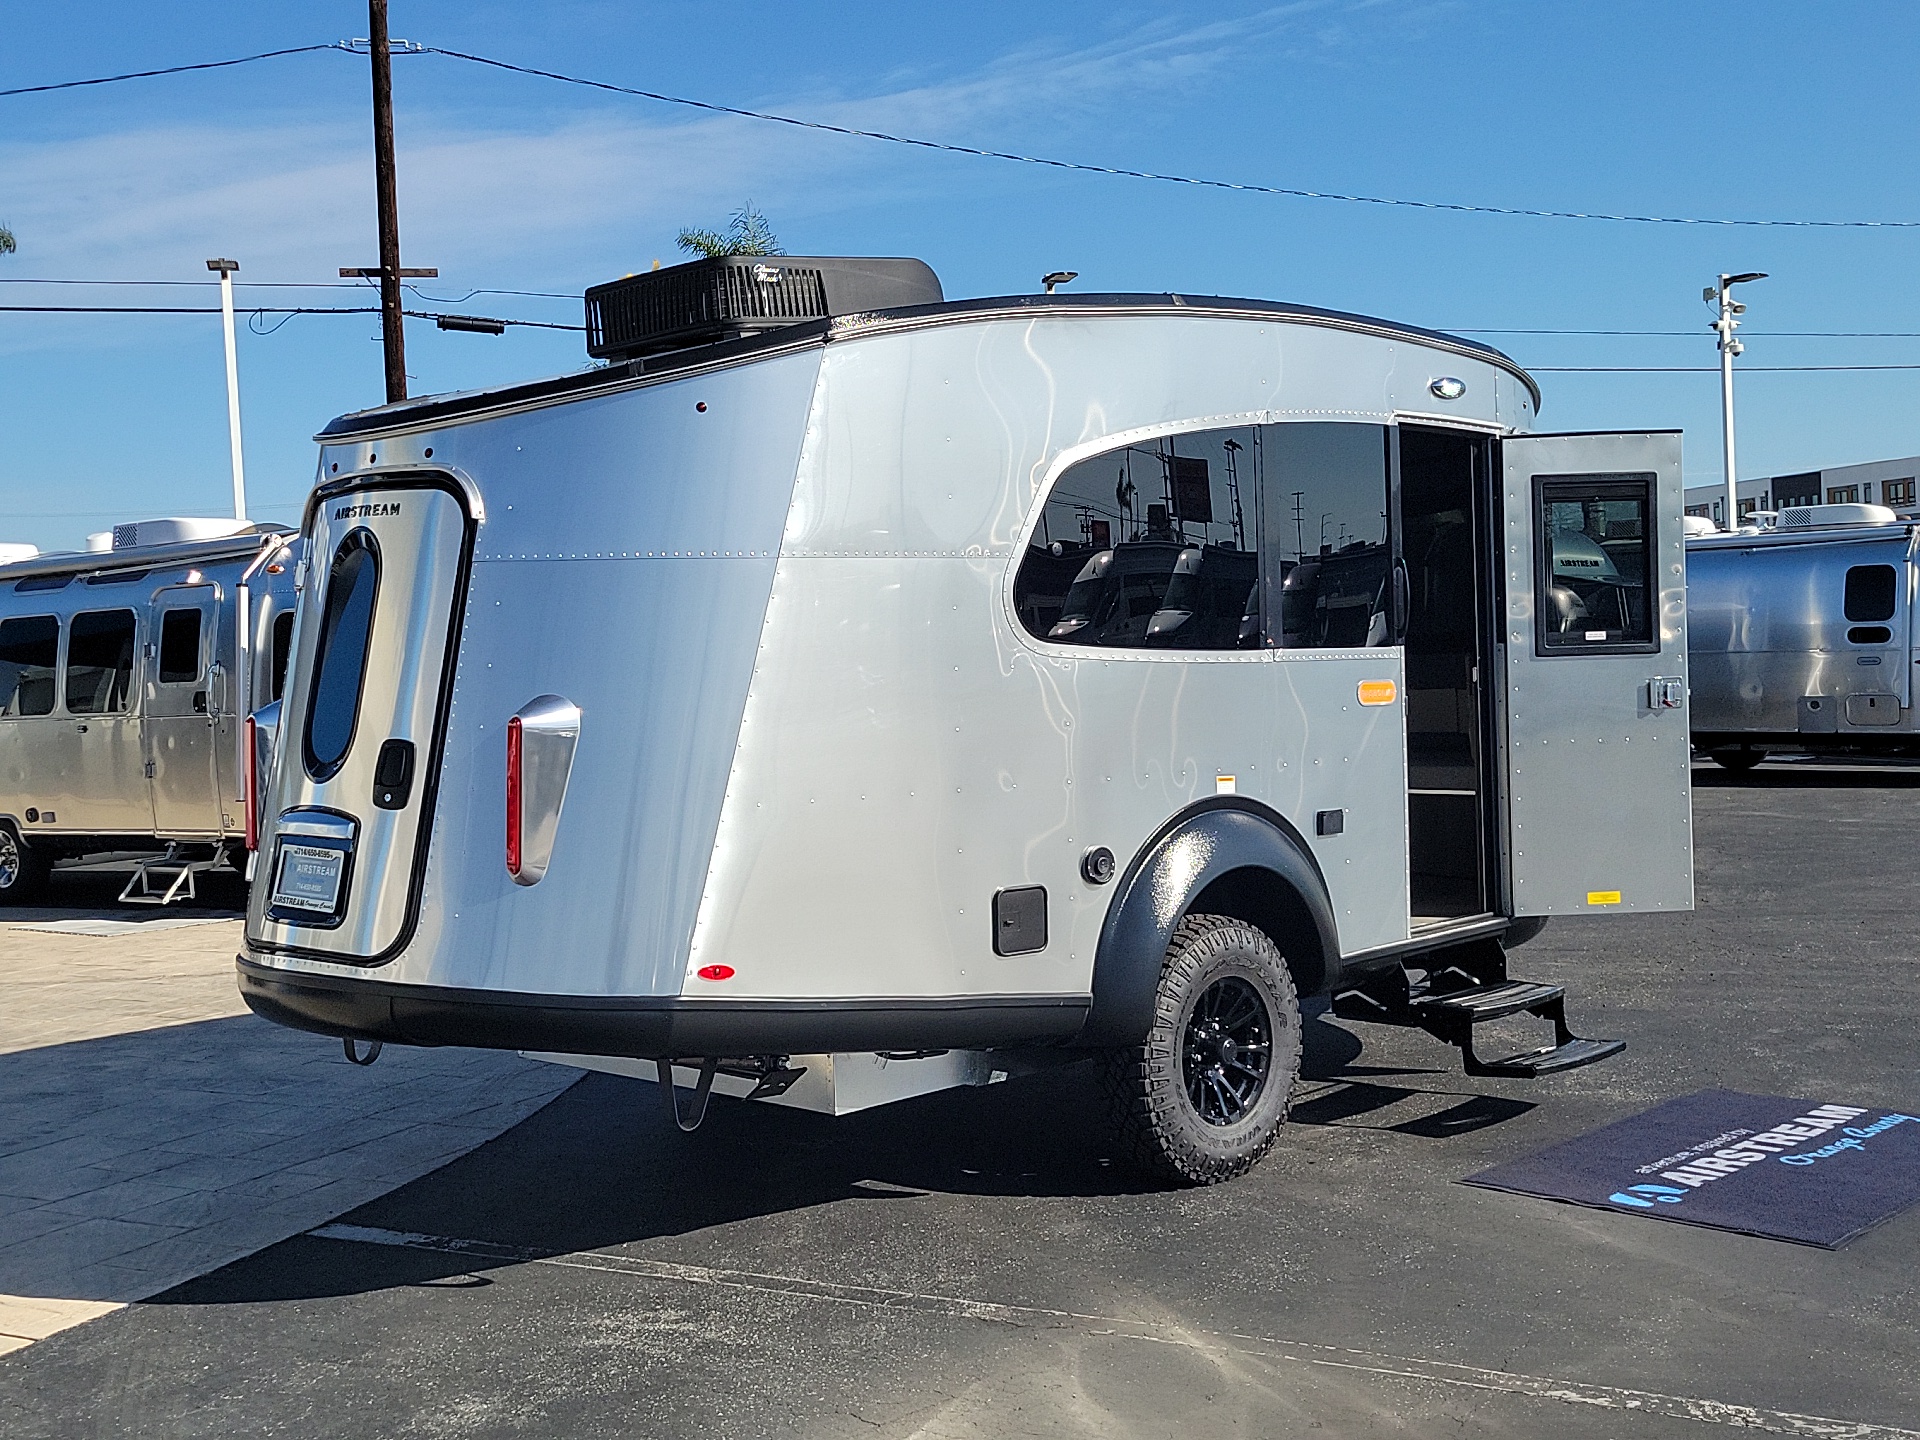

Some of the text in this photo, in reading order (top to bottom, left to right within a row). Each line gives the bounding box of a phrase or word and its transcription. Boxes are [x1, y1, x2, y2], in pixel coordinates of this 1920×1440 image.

[334, 503, 401, 521] AIRSTREAM
[1560, 559, 1600, 568] AIRSTREAM
[296, 864, 336, 877] AIRSTREAM
[273, 895, 305, 907] AIRSTREAM
[1659, 1104, 1868, 1188] AIRSTREAM
[1779, 1113, 1920, 1165] Orange County
